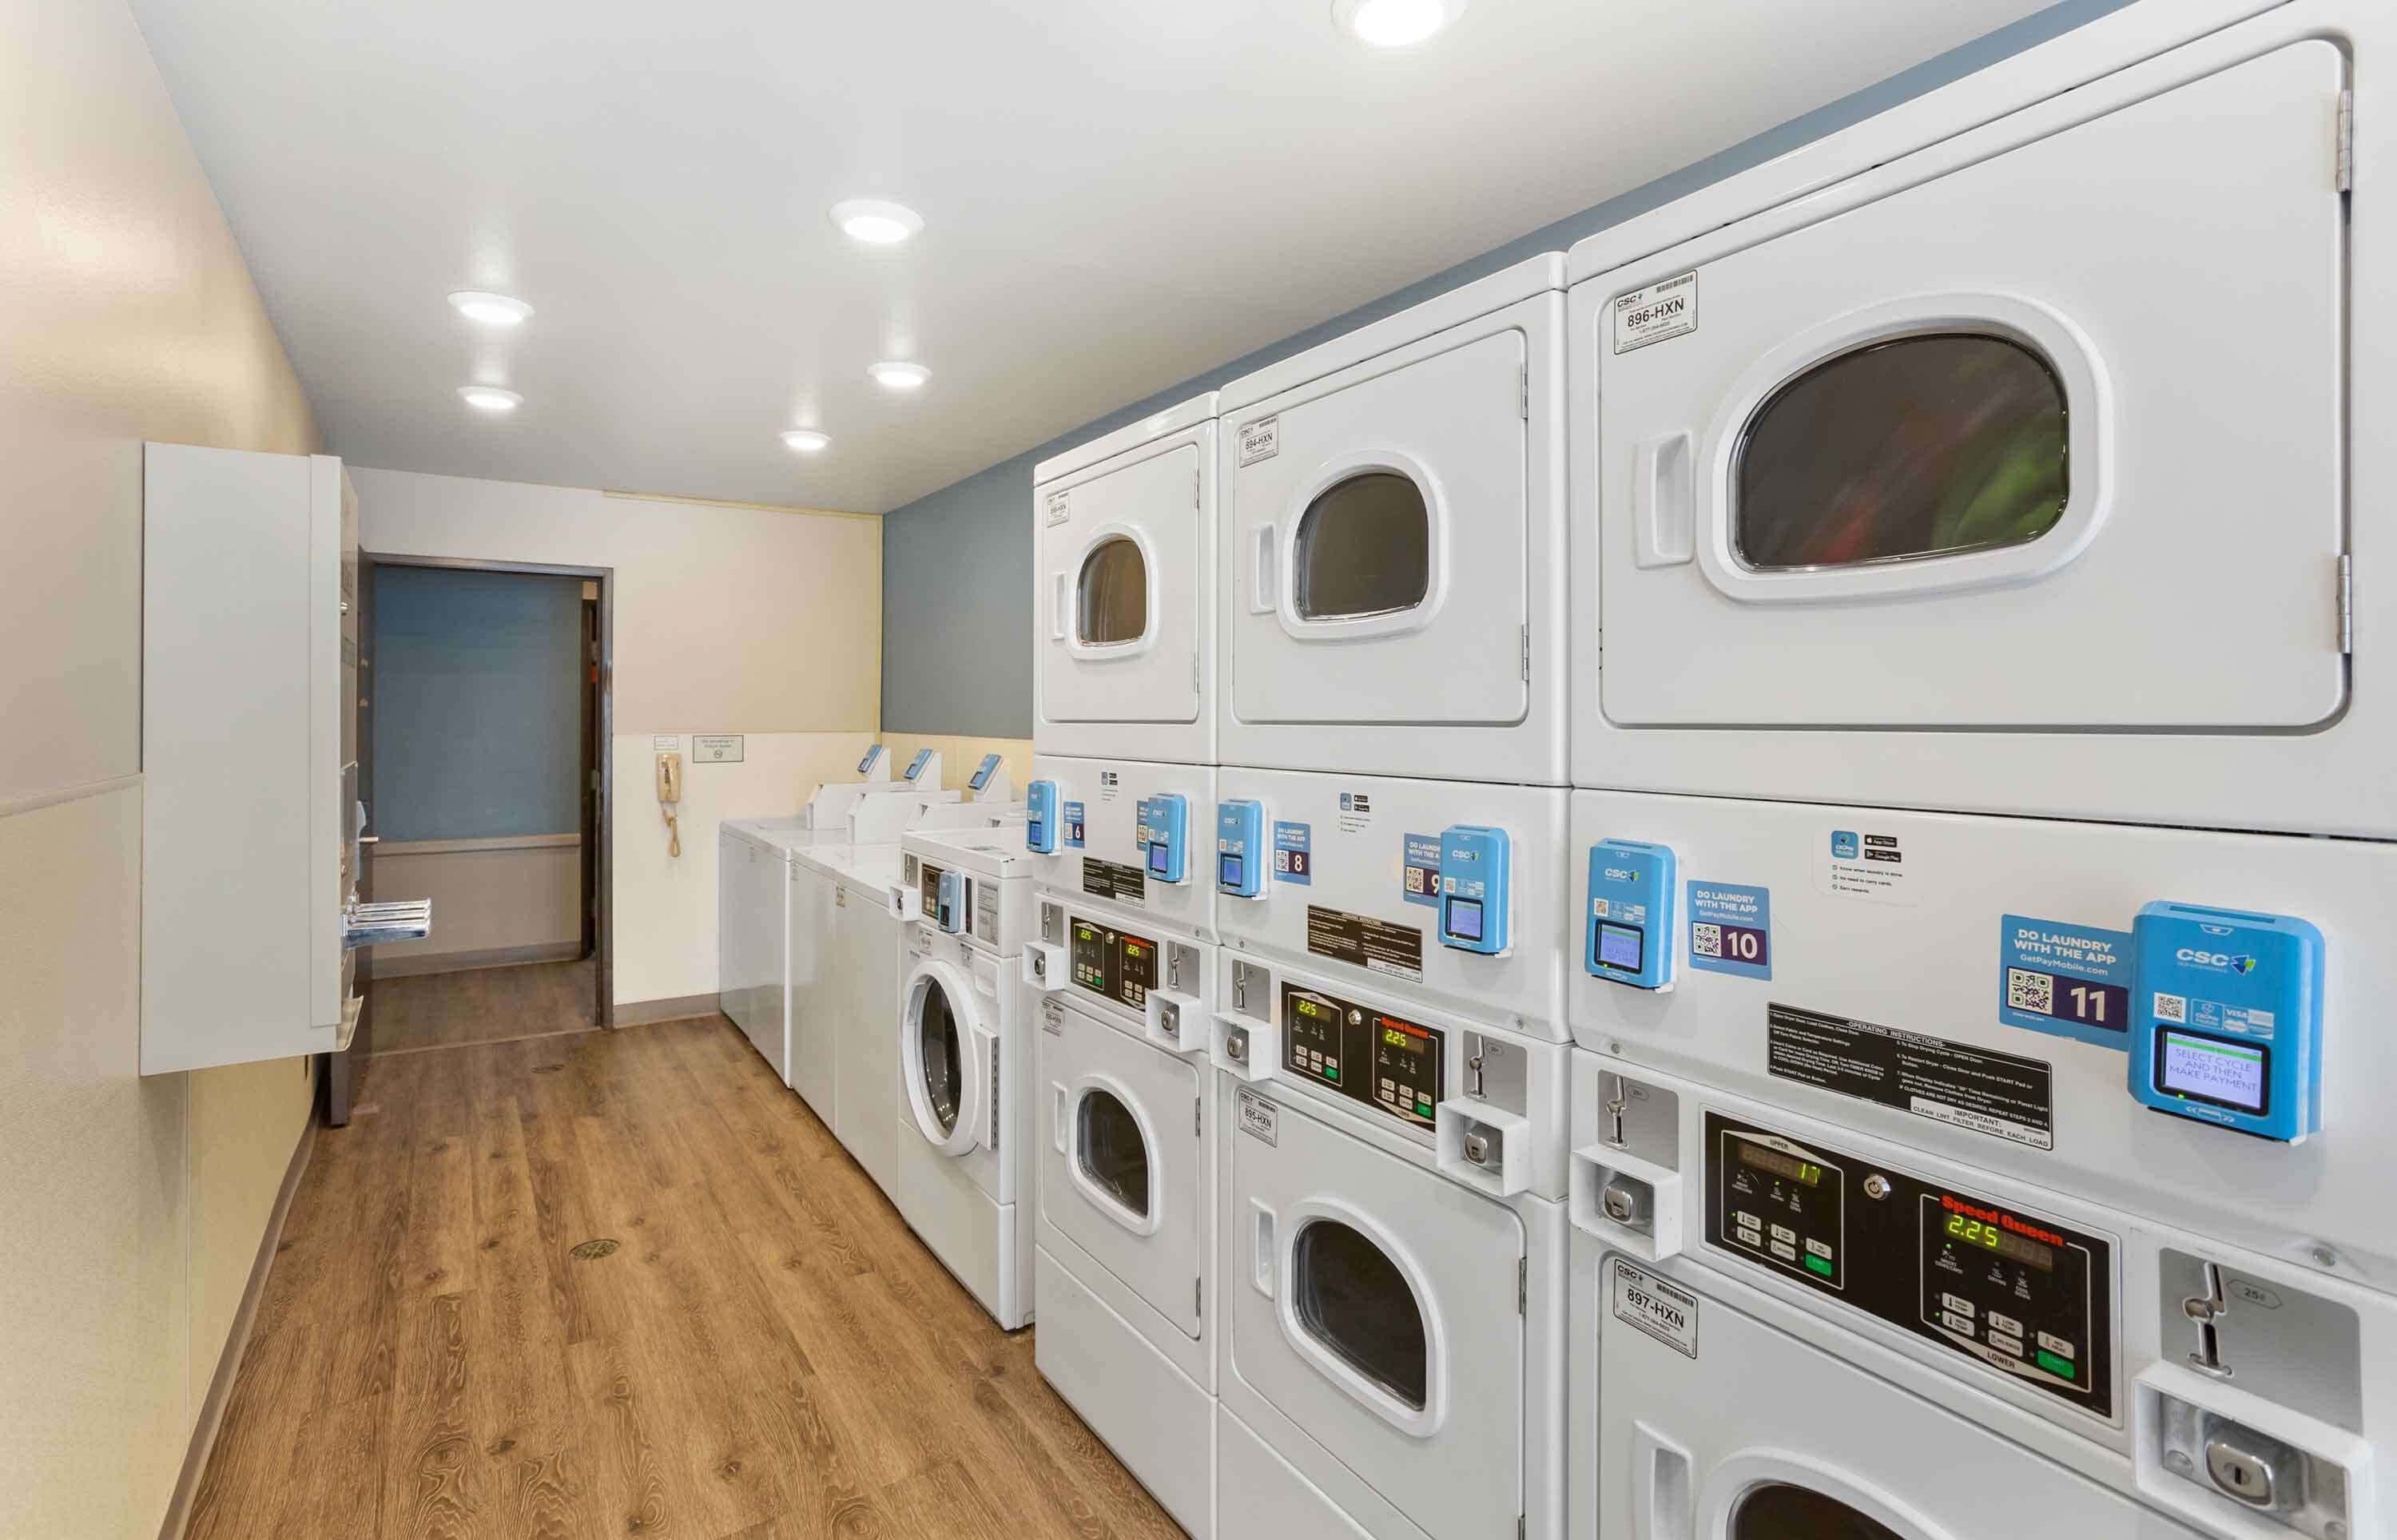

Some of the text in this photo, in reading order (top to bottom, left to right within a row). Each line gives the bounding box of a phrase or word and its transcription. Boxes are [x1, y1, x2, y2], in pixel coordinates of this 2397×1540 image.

[1628, 297, 1683, 327] 896-HXN
[1075, 826, 1080, 839] 6
[1294, 855, 1302, 871] 8
[1452, 849, 1470, 859] CSC
[1604, 868, 1628, 879] CSC
[1695, 899, 1758, 913] WITH THE APP
[1711, 892, 1755, 903] LAUNDRY
[1727, 931, 1758, 959] 10
[2017, 929, 2112, 953] DO LAUNDRY
[2013, 939, 2117, 965] WITH THE APP
[2176, 948, 2229, 966] CSC
[2020, 953, 2109, 976] GetPayMobile.com
[2070, 986, 2105, 1022] 11
[2227, 1009, 2248, 1018] VISA
[2176, 1048, 2251, 1072] SELECT CYCLE
[2186, 1060, 2242, 1079] AND THEN
[2169, 1065, 2256, 1092] MAKE PAYMENT
[1914, 1105, 1934, 1117] CLEAN
[1936, 1112, 1950, 1121] LINT
[1953, 1116, 1974, 1127] FILTER
[1978, 1123, 2002, 1135] BEFORE
[2007, 1130, 2025, 1141] EACH
[2029, 1137, 2048, 1147] LOAD
[1954, 1109, 2001, 1127] IMPORTANT:
[1770, 1139, 1789, 1151] UPPER
[1942, 1194, 2065, 1247] Speed Queen
[1949, 1214, 1998, 1247] 2.25
[1617, 1264, 1637, 1280] CSC
[1628, 1288, 1684, 1328] 897-HXN
[1987, 1350, 2015, 1368] LOWER
